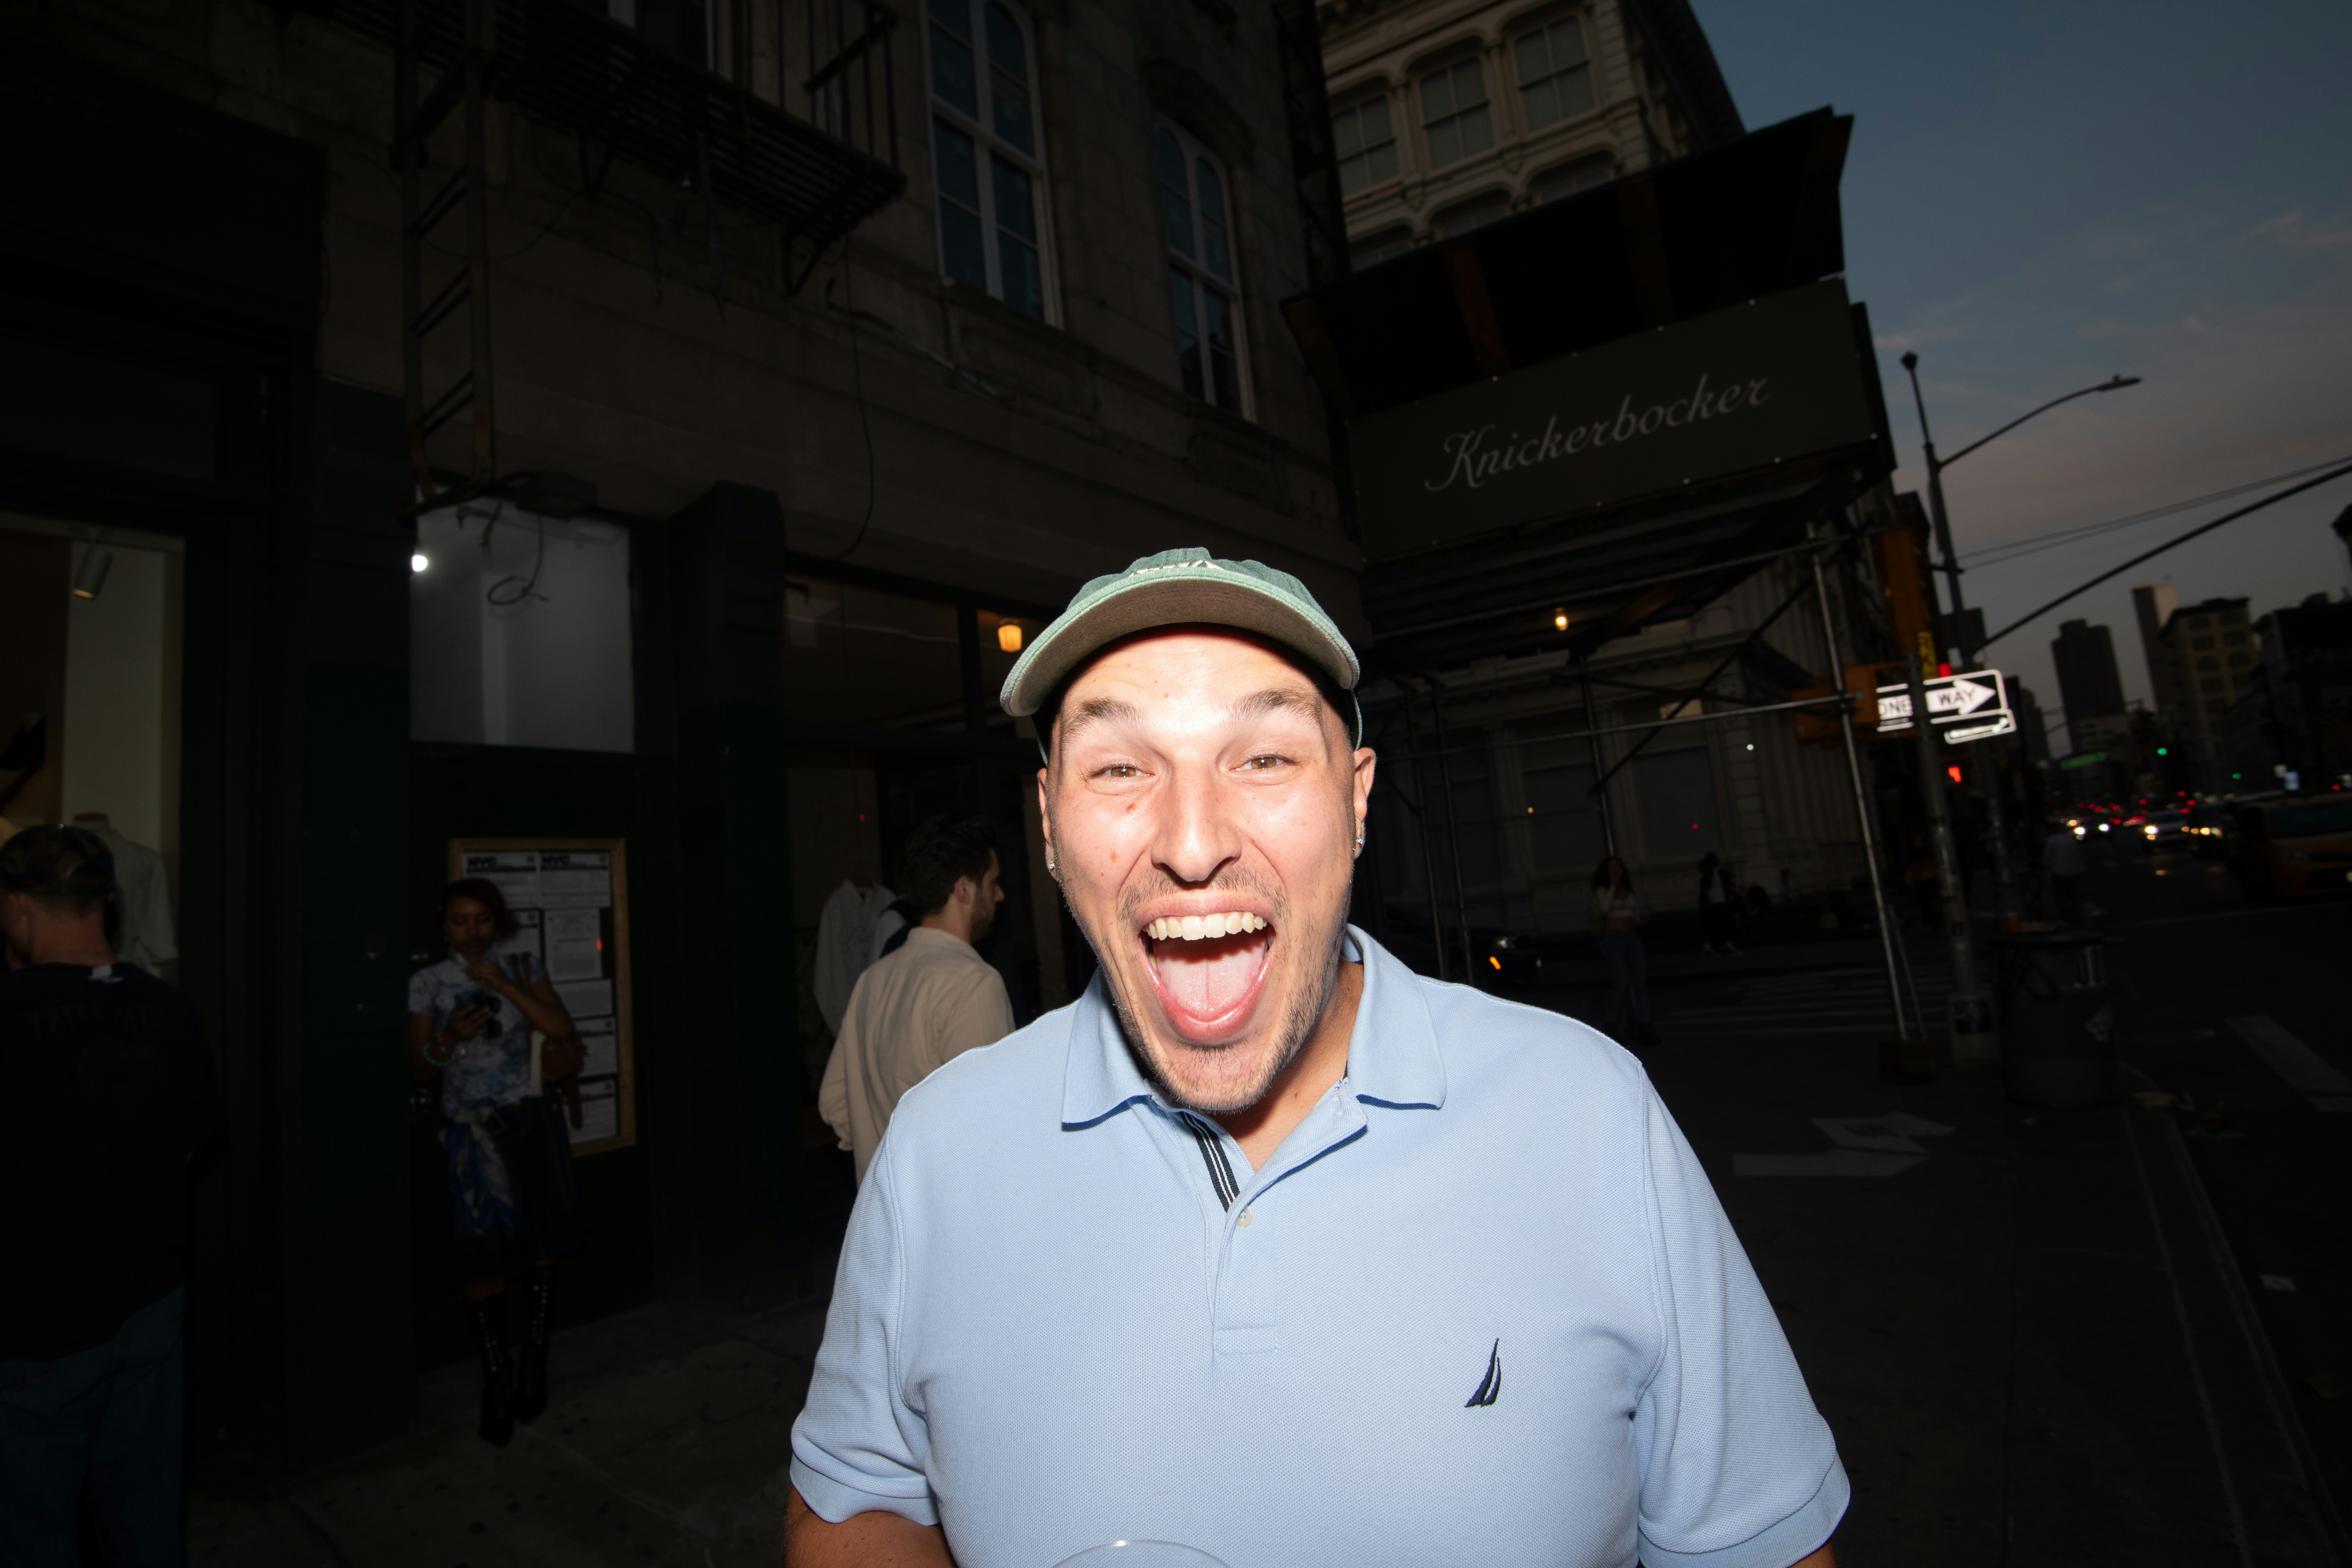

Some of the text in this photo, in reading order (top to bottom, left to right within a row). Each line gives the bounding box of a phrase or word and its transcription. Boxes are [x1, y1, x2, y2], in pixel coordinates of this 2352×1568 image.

[1424, 373, 1770, 491] Knickerbocker
[1938, 689, 1975, 706] WAY
[468, 857, 497, 867] NYC
[542, 855, 571, 866] NYC
